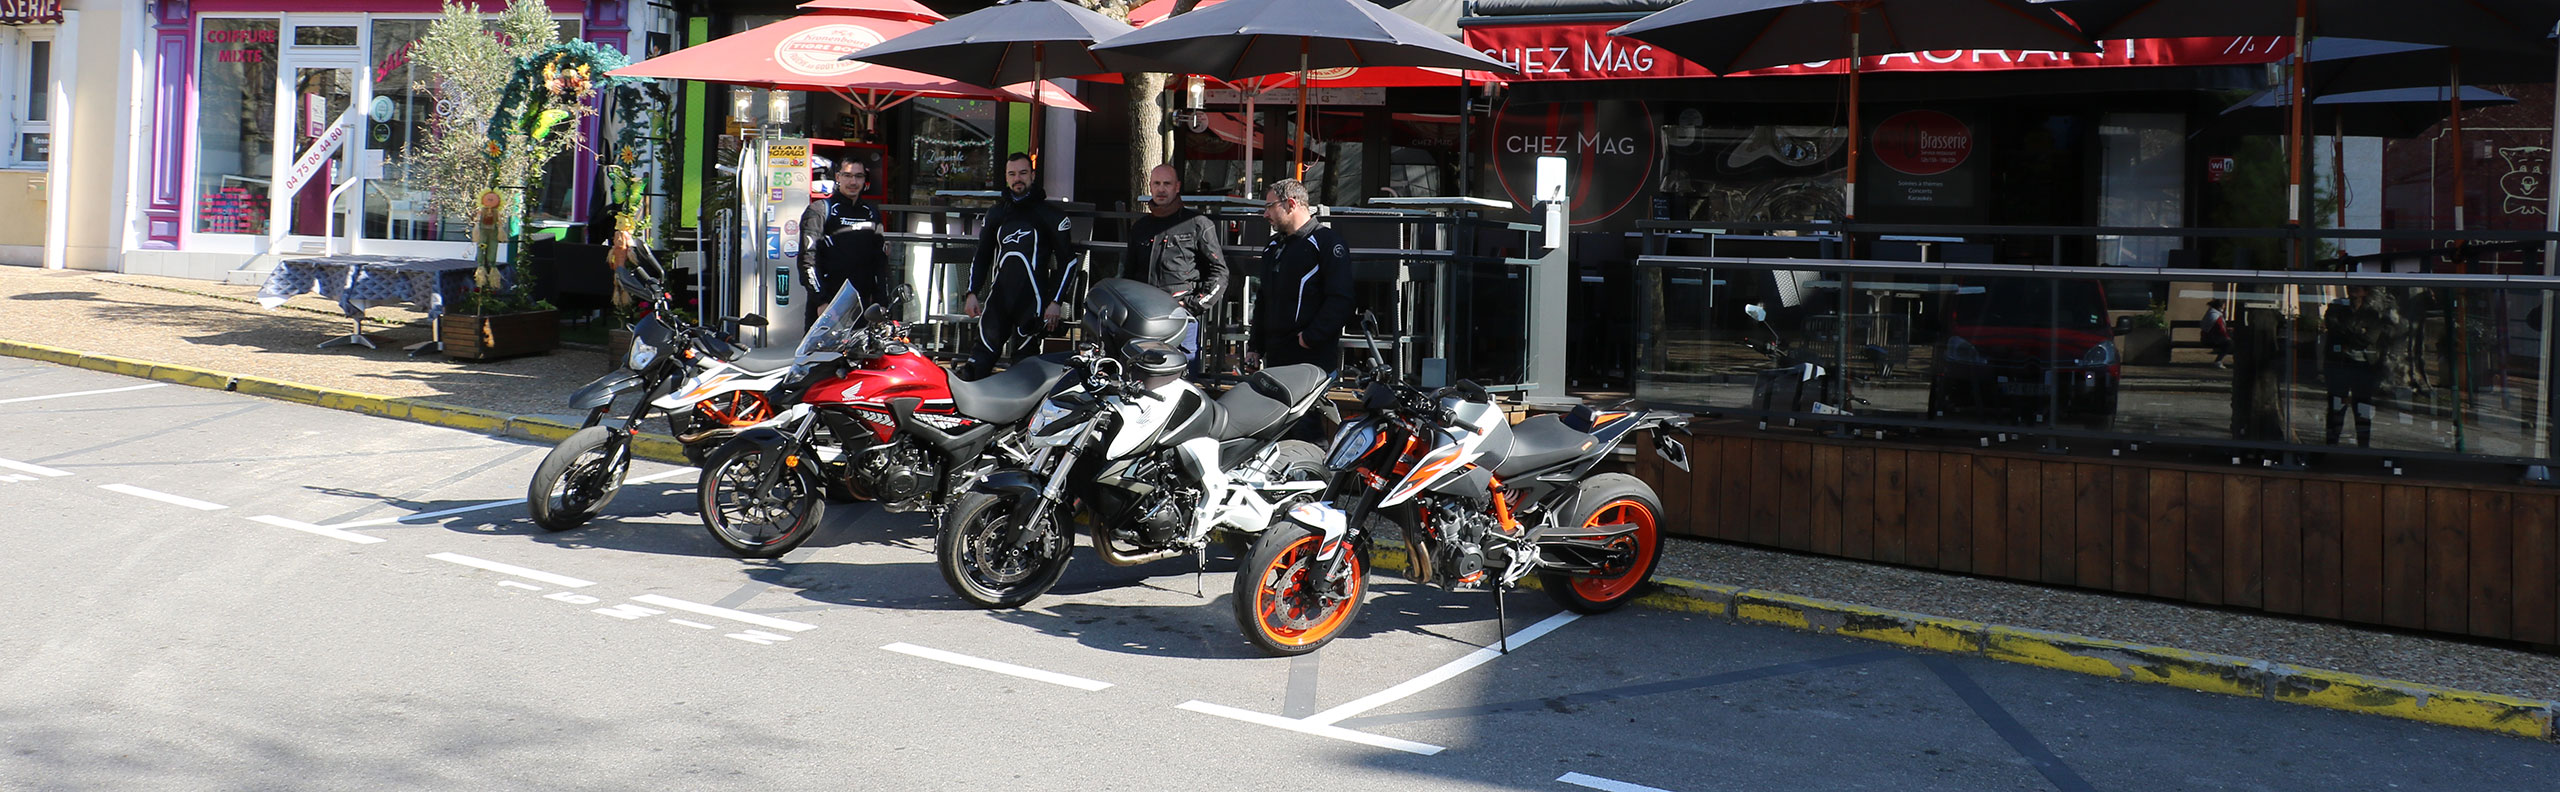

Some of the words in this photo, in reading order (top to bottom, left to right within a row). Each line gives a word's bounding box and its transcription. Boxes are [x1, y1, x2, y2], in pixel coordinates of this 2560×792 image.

[0, 0, 56, 17] SERIE
[207, 30, 277, 43] COIFFURE
[804, 34, 871, 48] Kronenbourg
[218, 49, 263, 63] MIXTE
[792, 43, 831, 51] TIGRE
[832, 45, 863, 54] BOC
[1584, 39, 1654, 72] MAG
[1506, 135, 1569, 154] CHEZ
[1577, 130, 1636, 155] MAG
[1921, 131, 1967, 149] Brasserie
[286, 175, 299, 190] 04
[296, 163, 310, 178] 75
[308, 152, 321, 166] 06
[319, 139, 332, 153] 44
[330, 127, 343, 142] 80
[1908, 187, 1933, 195] Concerts
